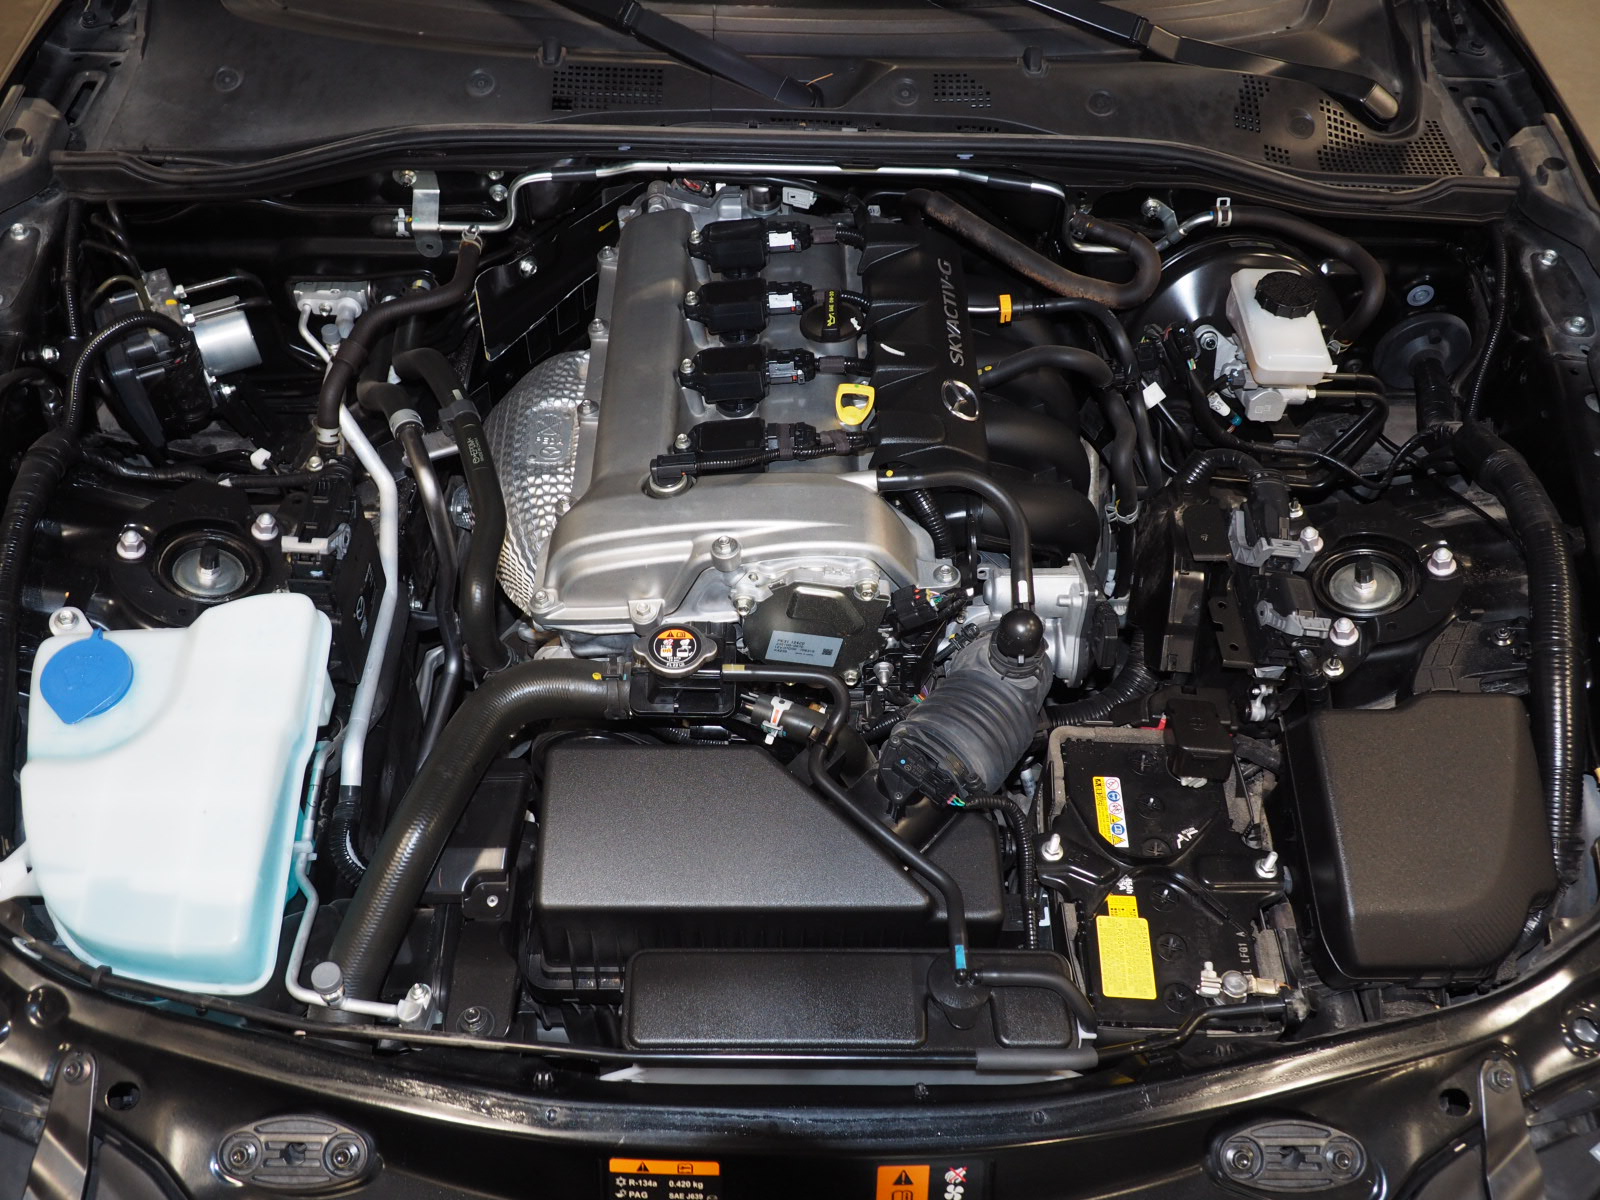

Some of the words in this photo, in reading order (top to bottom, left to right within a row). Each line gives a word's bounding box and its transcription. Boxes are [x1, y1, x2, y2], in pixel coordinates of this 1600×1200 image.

[937, 258, 965, 367] SKYACTIV-G
[628, 1179, 658, 1188] R-134a
[668, 1180, 691, 1188] 0.420
[693, 1181, 704, 1190] kg
[628, 1191, 648, 1199] PAG
